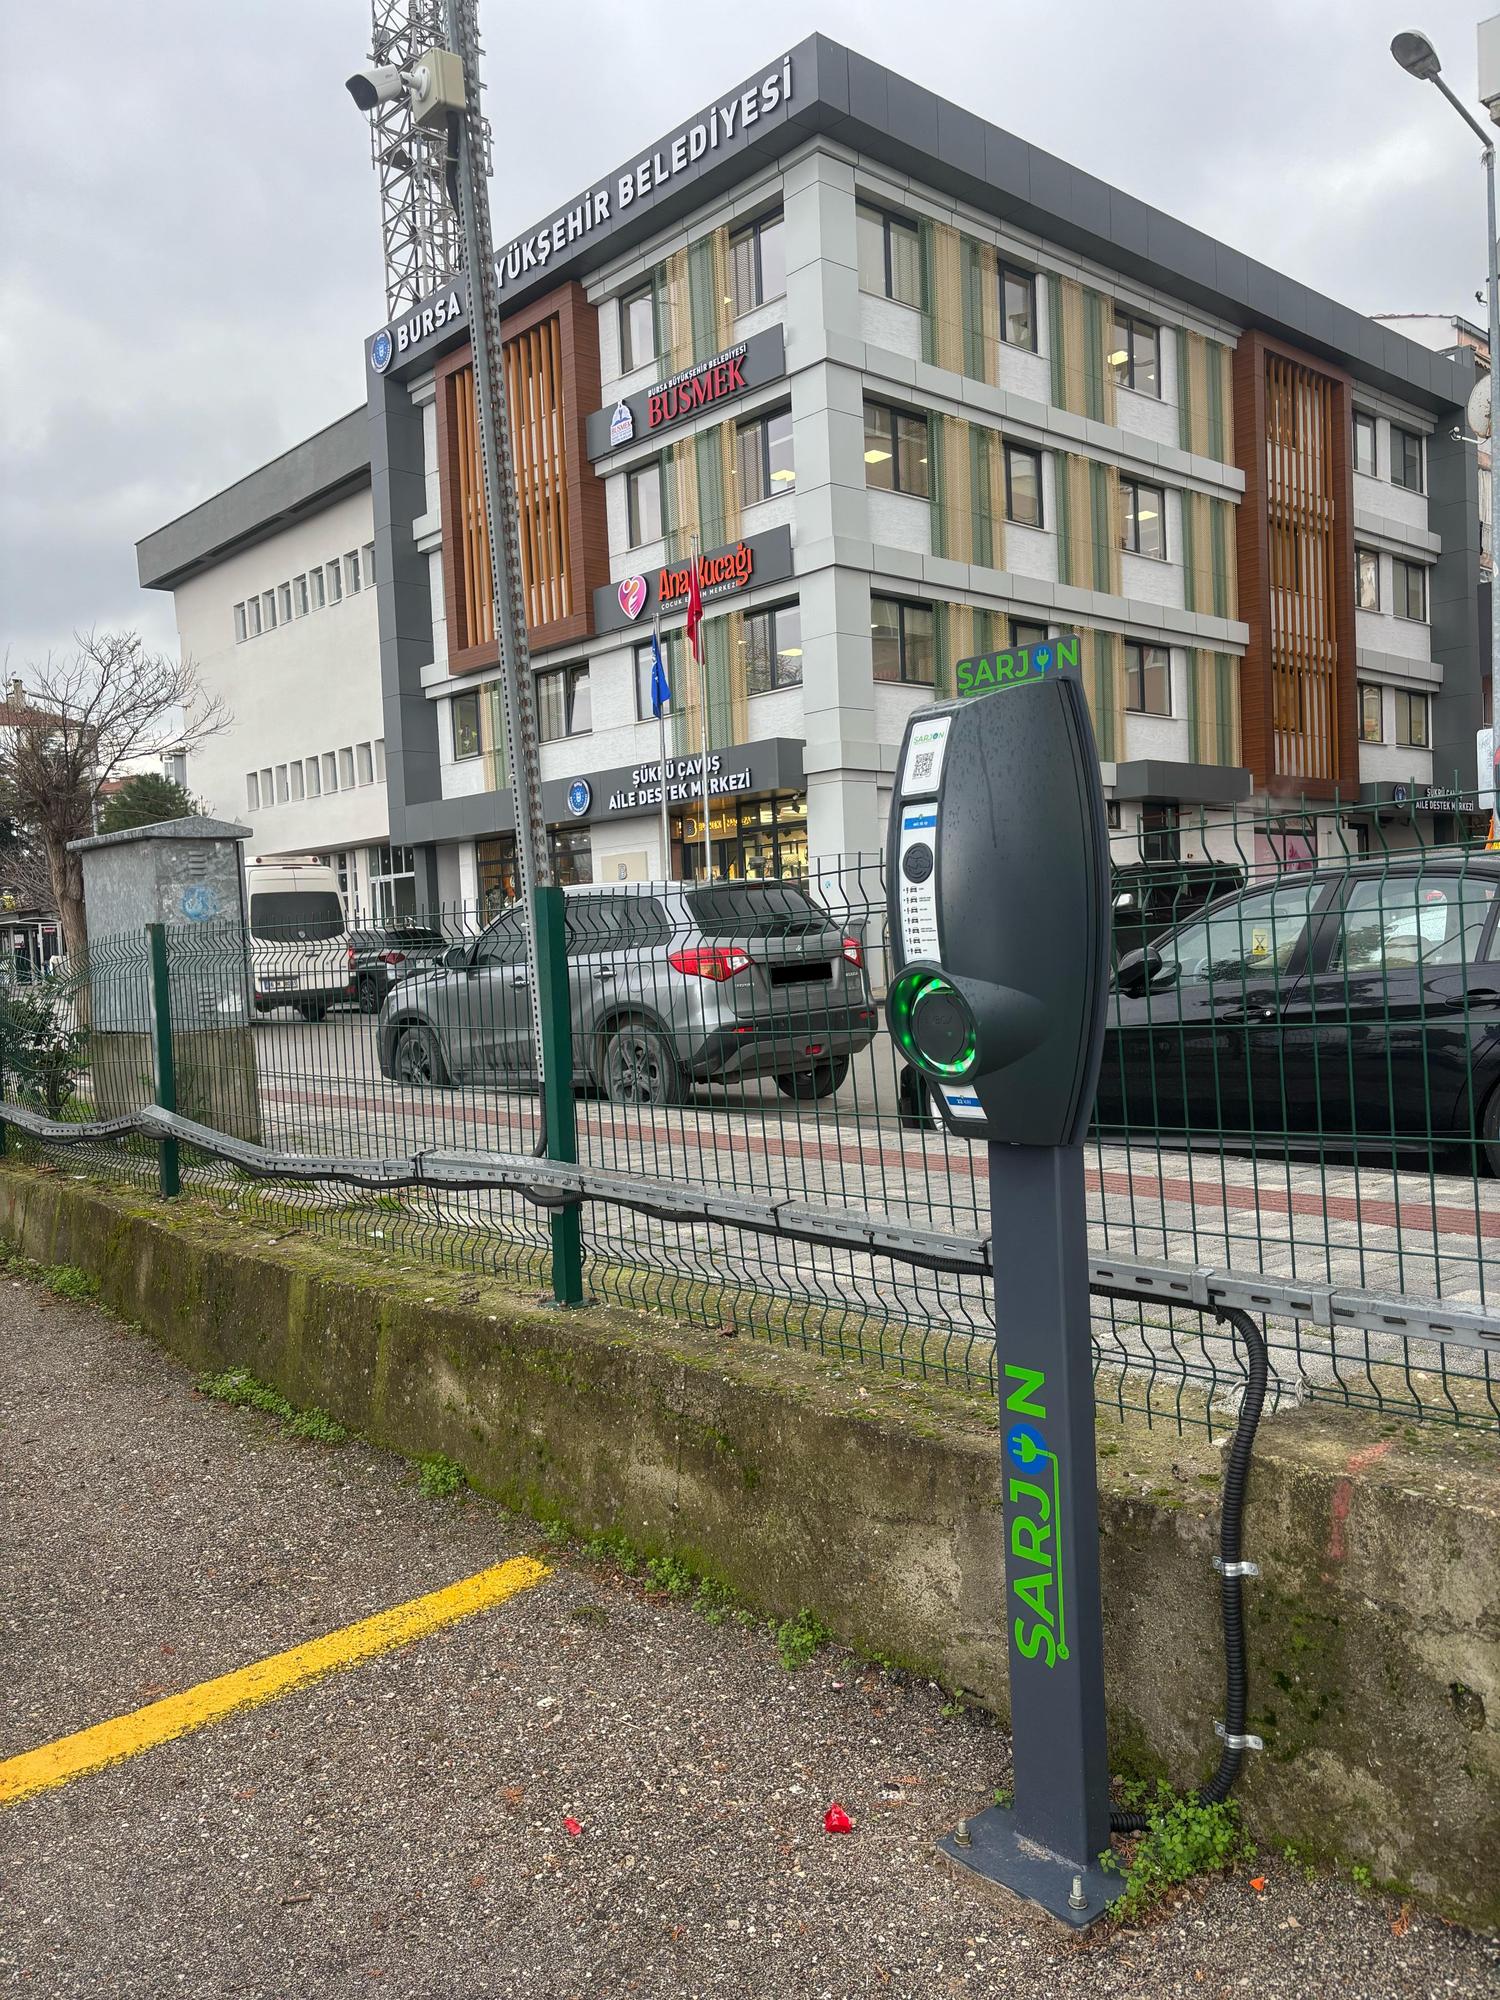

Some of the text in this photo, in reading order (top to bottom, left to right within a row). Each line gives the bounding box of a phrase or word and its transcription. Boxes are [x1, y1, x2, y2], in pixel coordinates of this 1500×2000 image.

[397, 55, 791, 352] BURSA YÜKŞEHİR BELEDİYESİ
[647, 342, 747, 398] BURSA BÜYÜKŞEHİR BELEDİYESİ
[648, 354, 746, 428] BUSMEK
[658, 568, 690, 601] Ana
[709, 582, 738, 596] MERKEZ
[608, 790, 636, 810] AİLE
[1451, 801, 1474, 812] MRKEZİ
